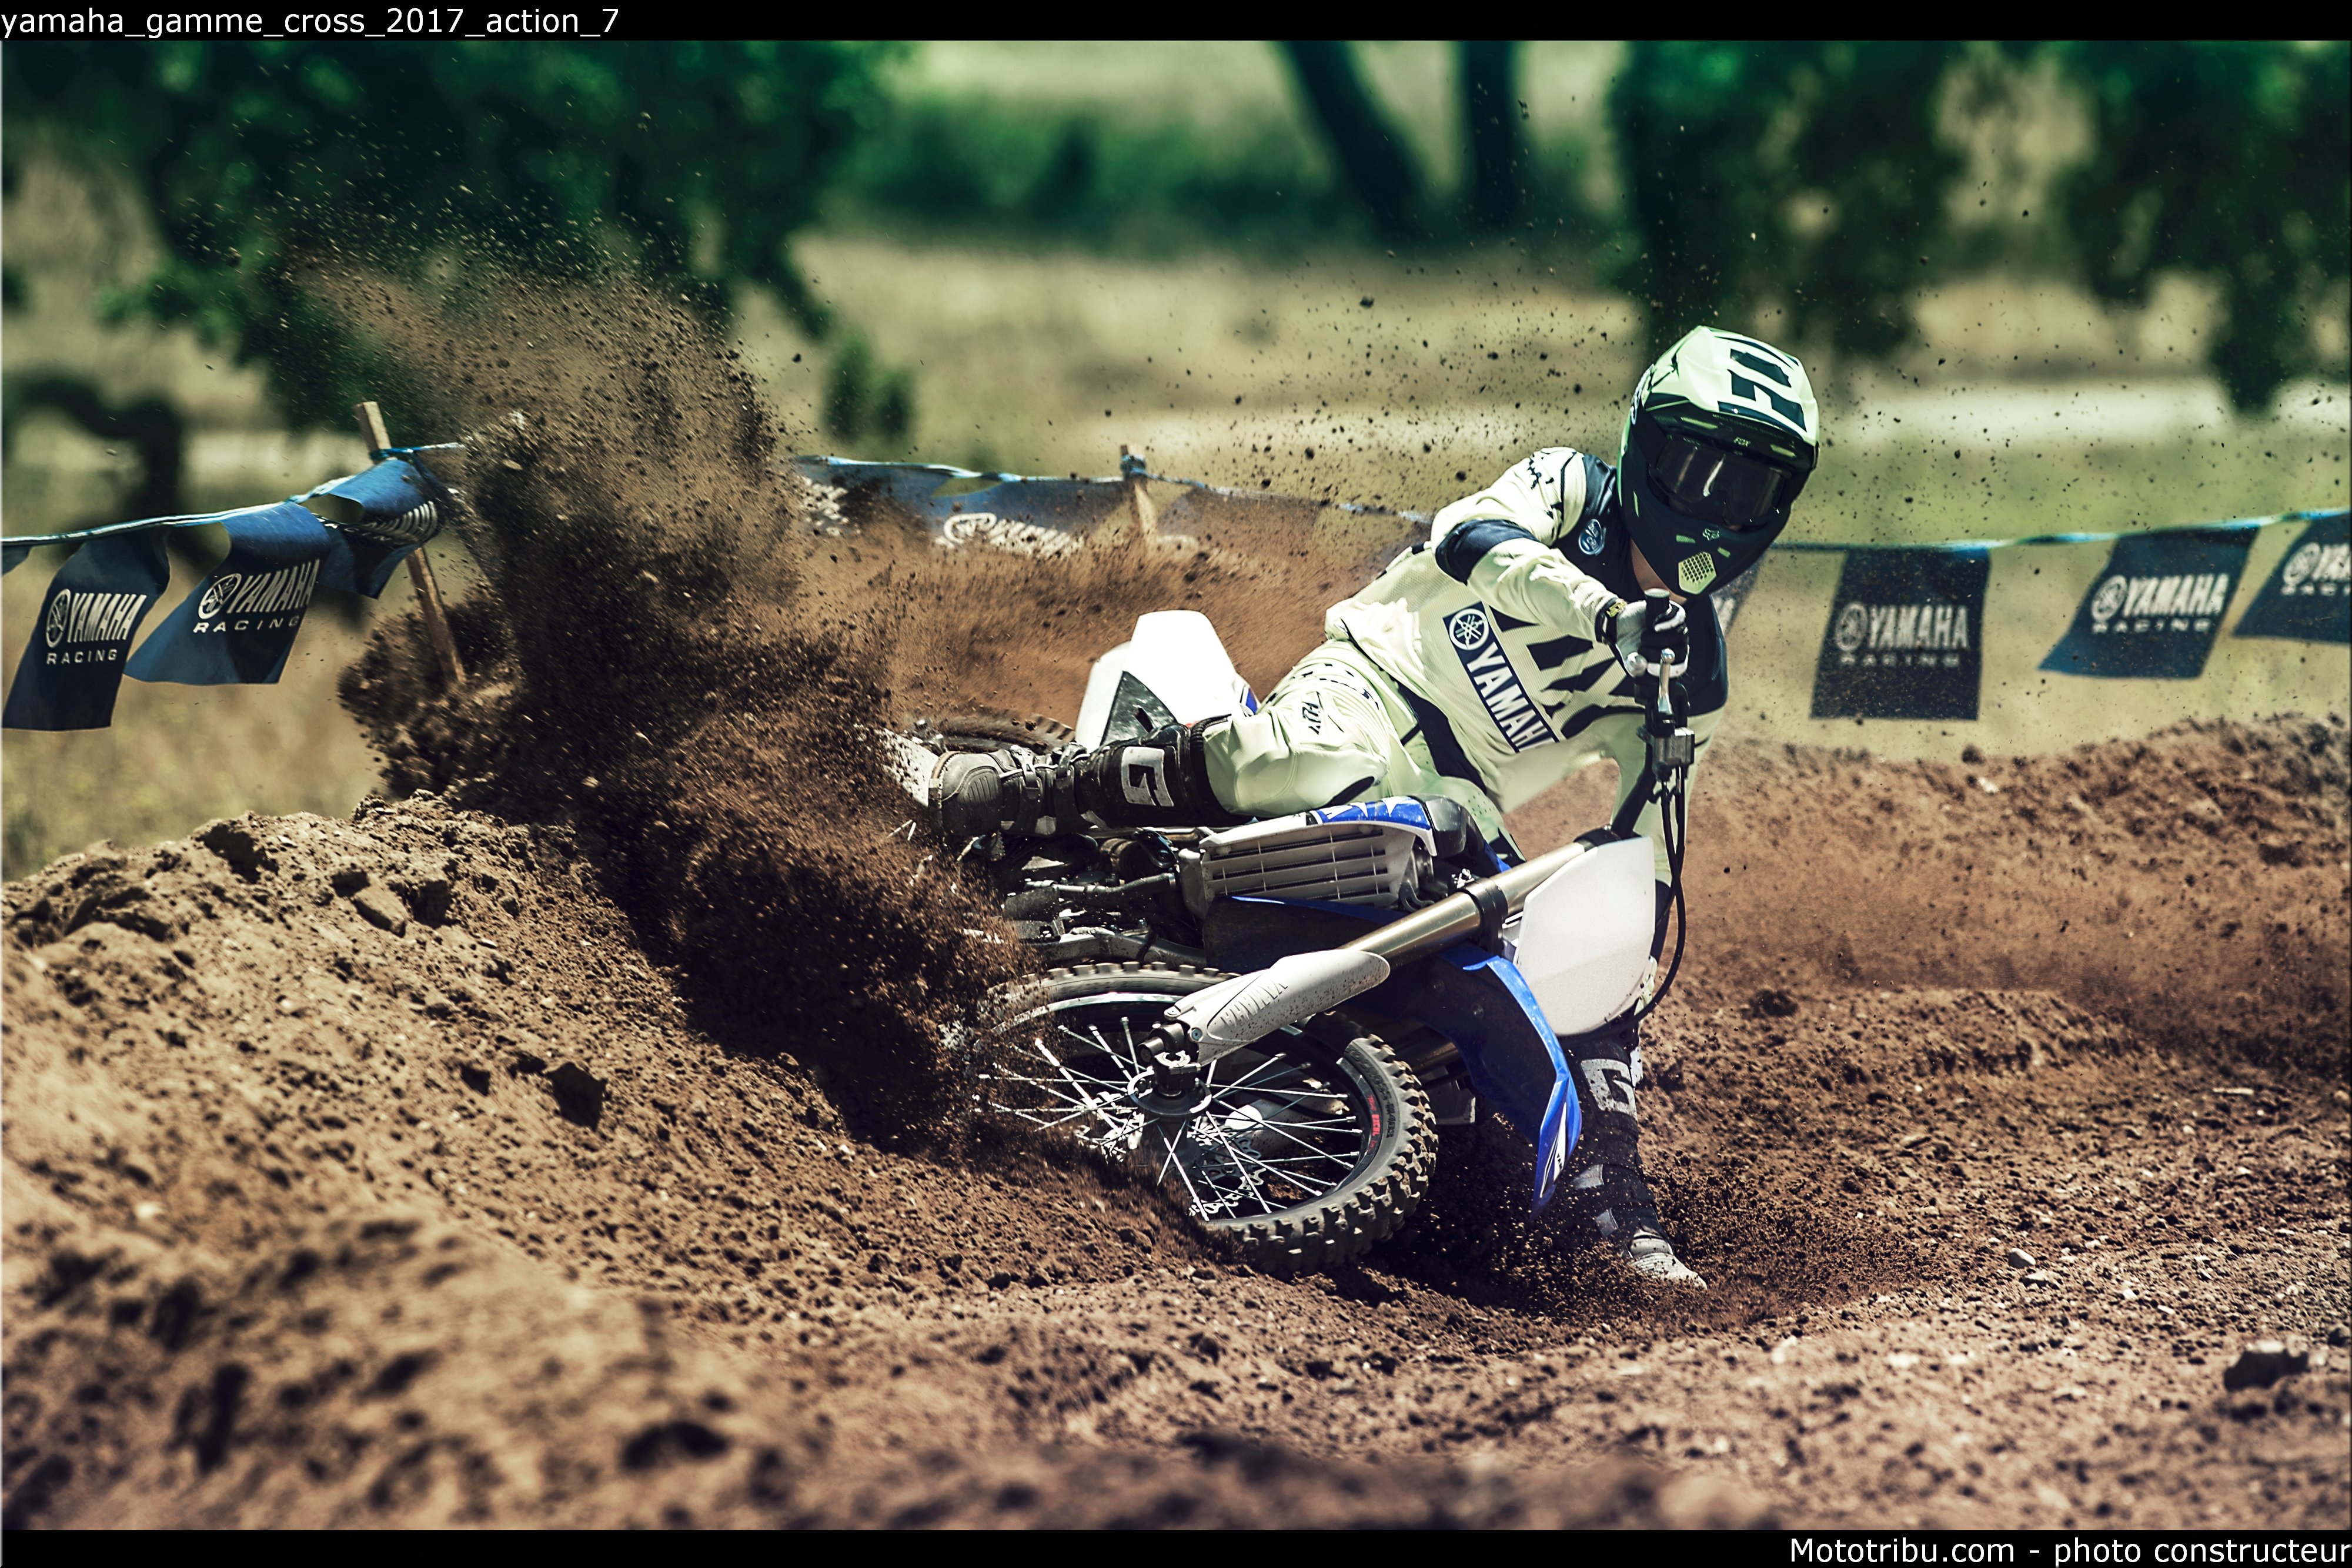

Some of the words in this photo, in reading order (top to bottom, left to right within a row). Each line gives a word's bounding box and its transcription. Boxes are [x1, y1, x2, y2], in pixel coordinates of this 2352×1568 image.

[226, 559, 320, 614] YAMAHA
[2122, 573, 2229, 616] YAMAHA
[67, 593, 147, 643] YAMAHA
[193, 616, 299, 633] RACING
[1868, 604, 1968, 648] YAMAHA
[46, 648, 118, 665] RACING
[1372, 1114, 1381, 1136] EXCEL
